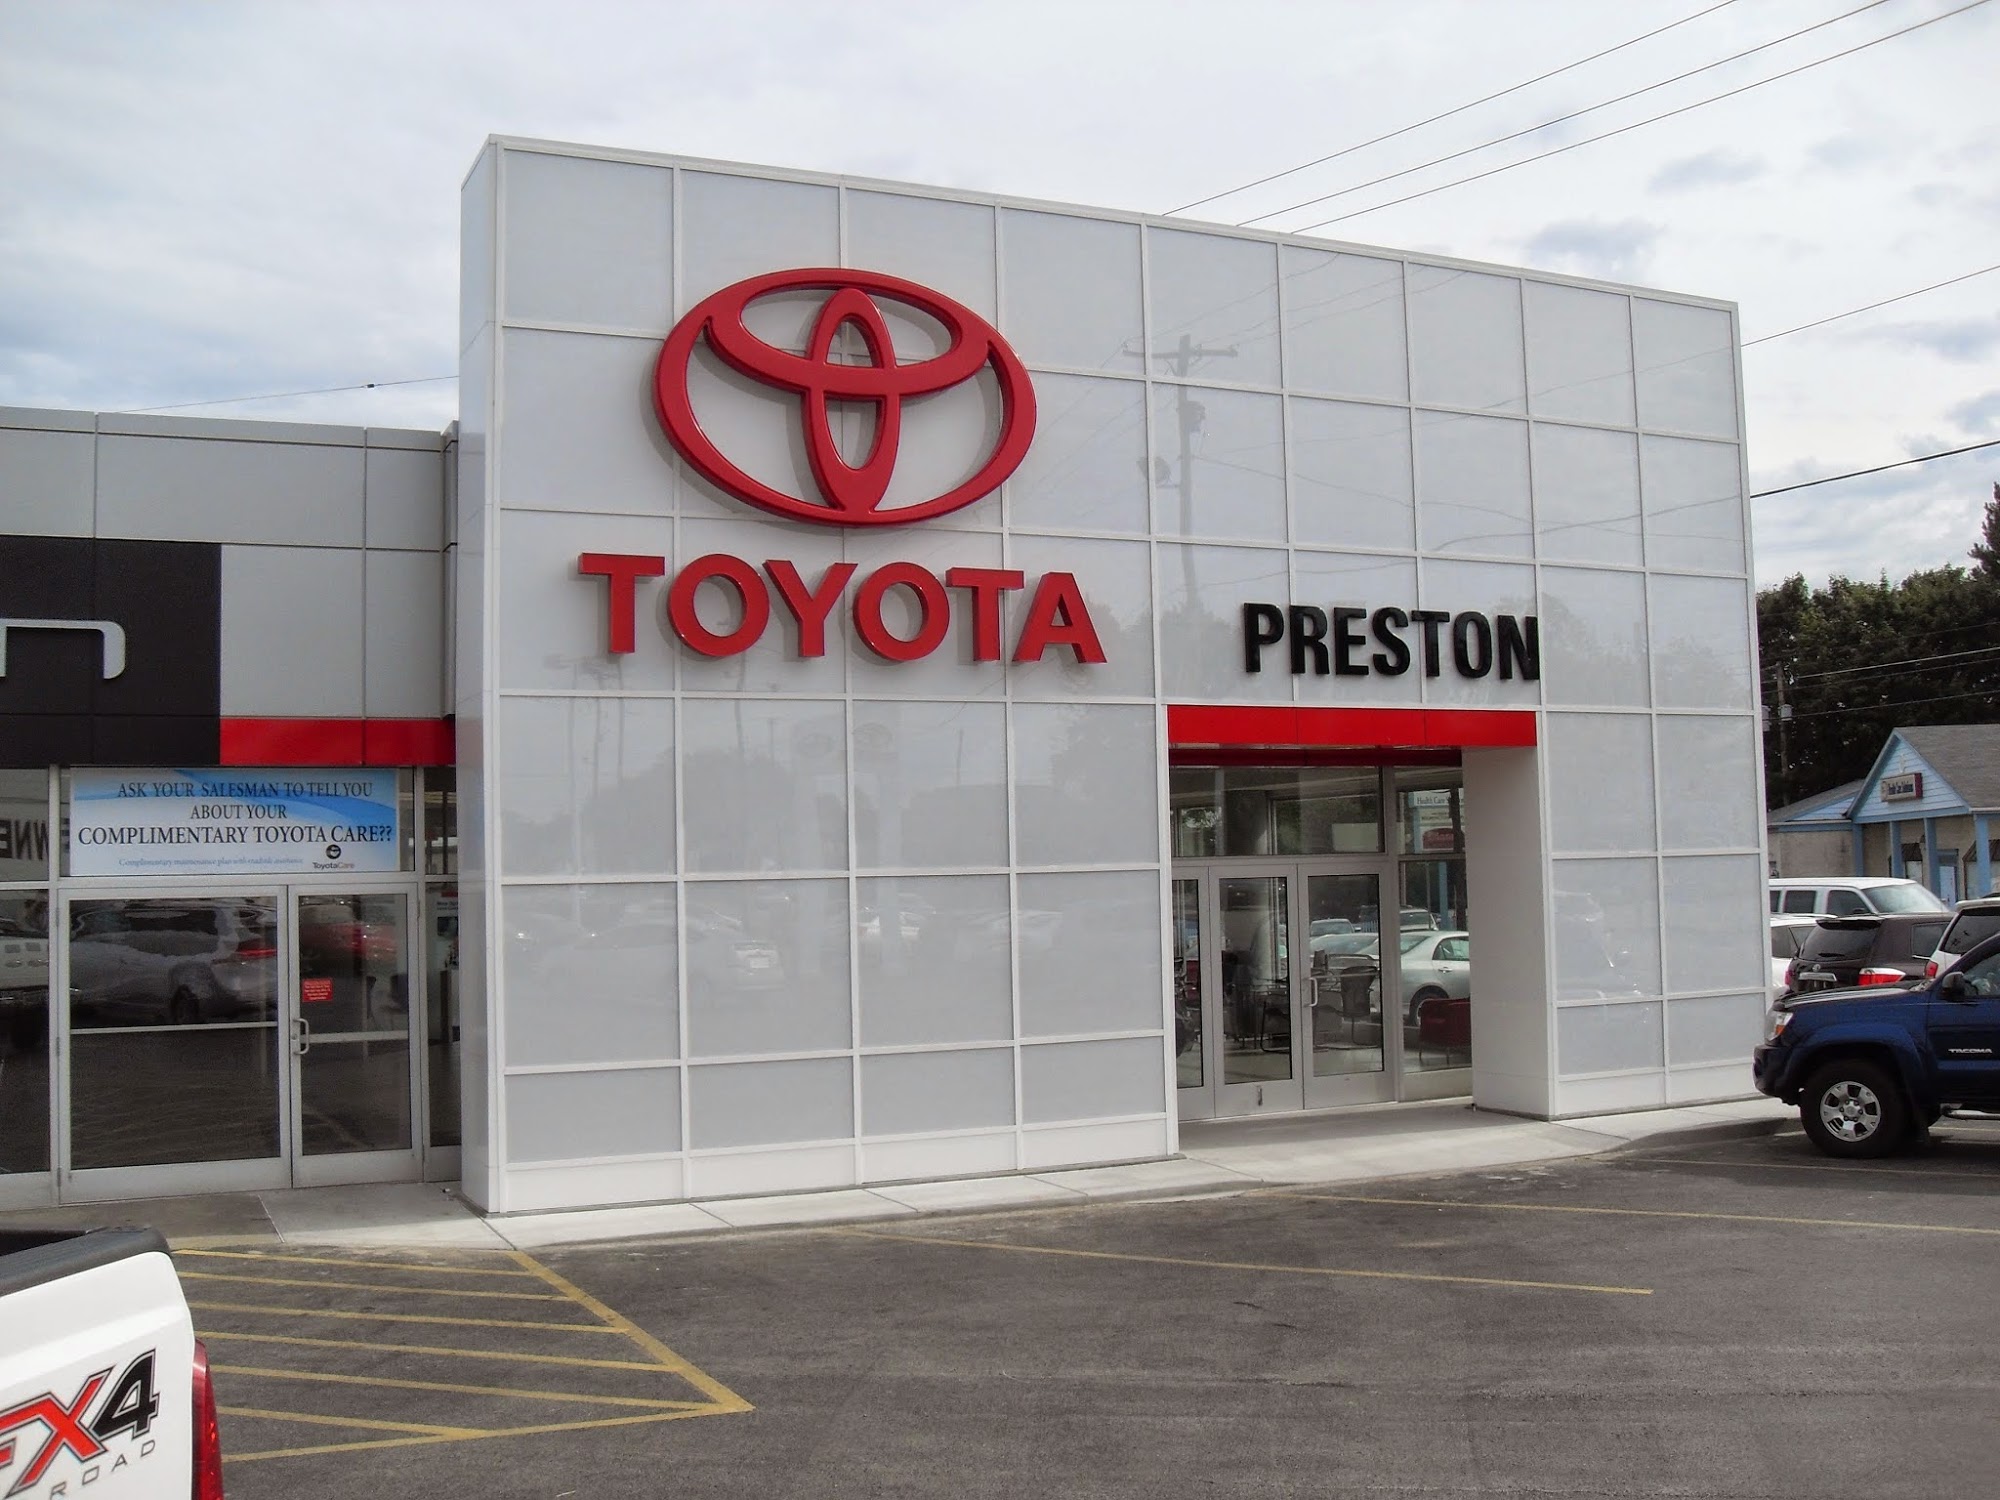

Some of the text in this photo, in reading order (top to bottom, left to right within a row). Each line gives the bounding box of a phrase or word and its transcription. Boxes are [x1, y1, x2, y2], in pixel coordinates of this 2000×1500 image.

[578, 552, 1107, 664] TOYOTA
[1244, 603, 1540, 681] PRESTON
[117, 782, 373, 798] ASK YOUR SALESMAN TO TELL YOU
[190, 804, 287, 820] ABOUT YOUR
[78, 824, 393, 845] COMPLIMENTARY TOYOTA CARE??
[312, 861, 355, 870] ToyotaCare
[50, 1439, 156, 1500] ROAD
